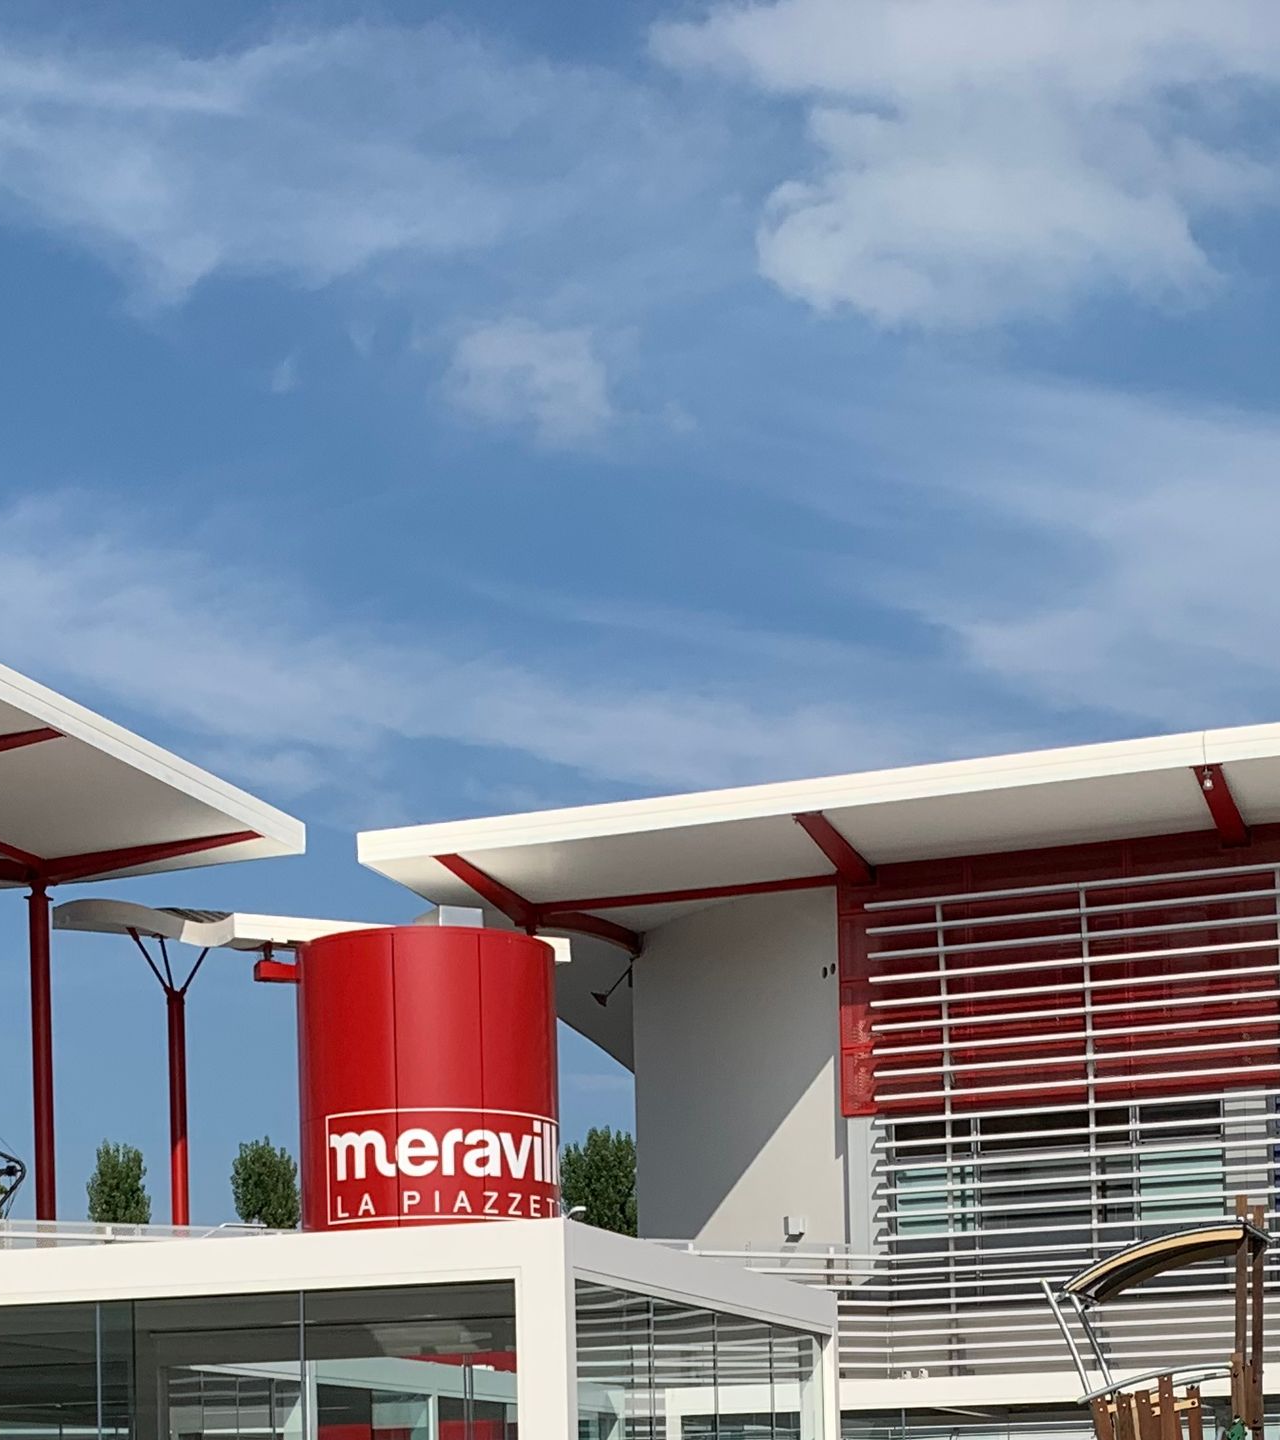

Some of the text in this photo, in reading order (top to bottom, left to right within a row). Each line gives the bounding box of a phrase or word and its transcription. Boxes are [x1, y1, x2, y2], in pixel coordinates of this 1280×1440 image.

[329, 1120, 560, 1187] meravill
[337, 1190, 561, 1218] LA PIAZZET
